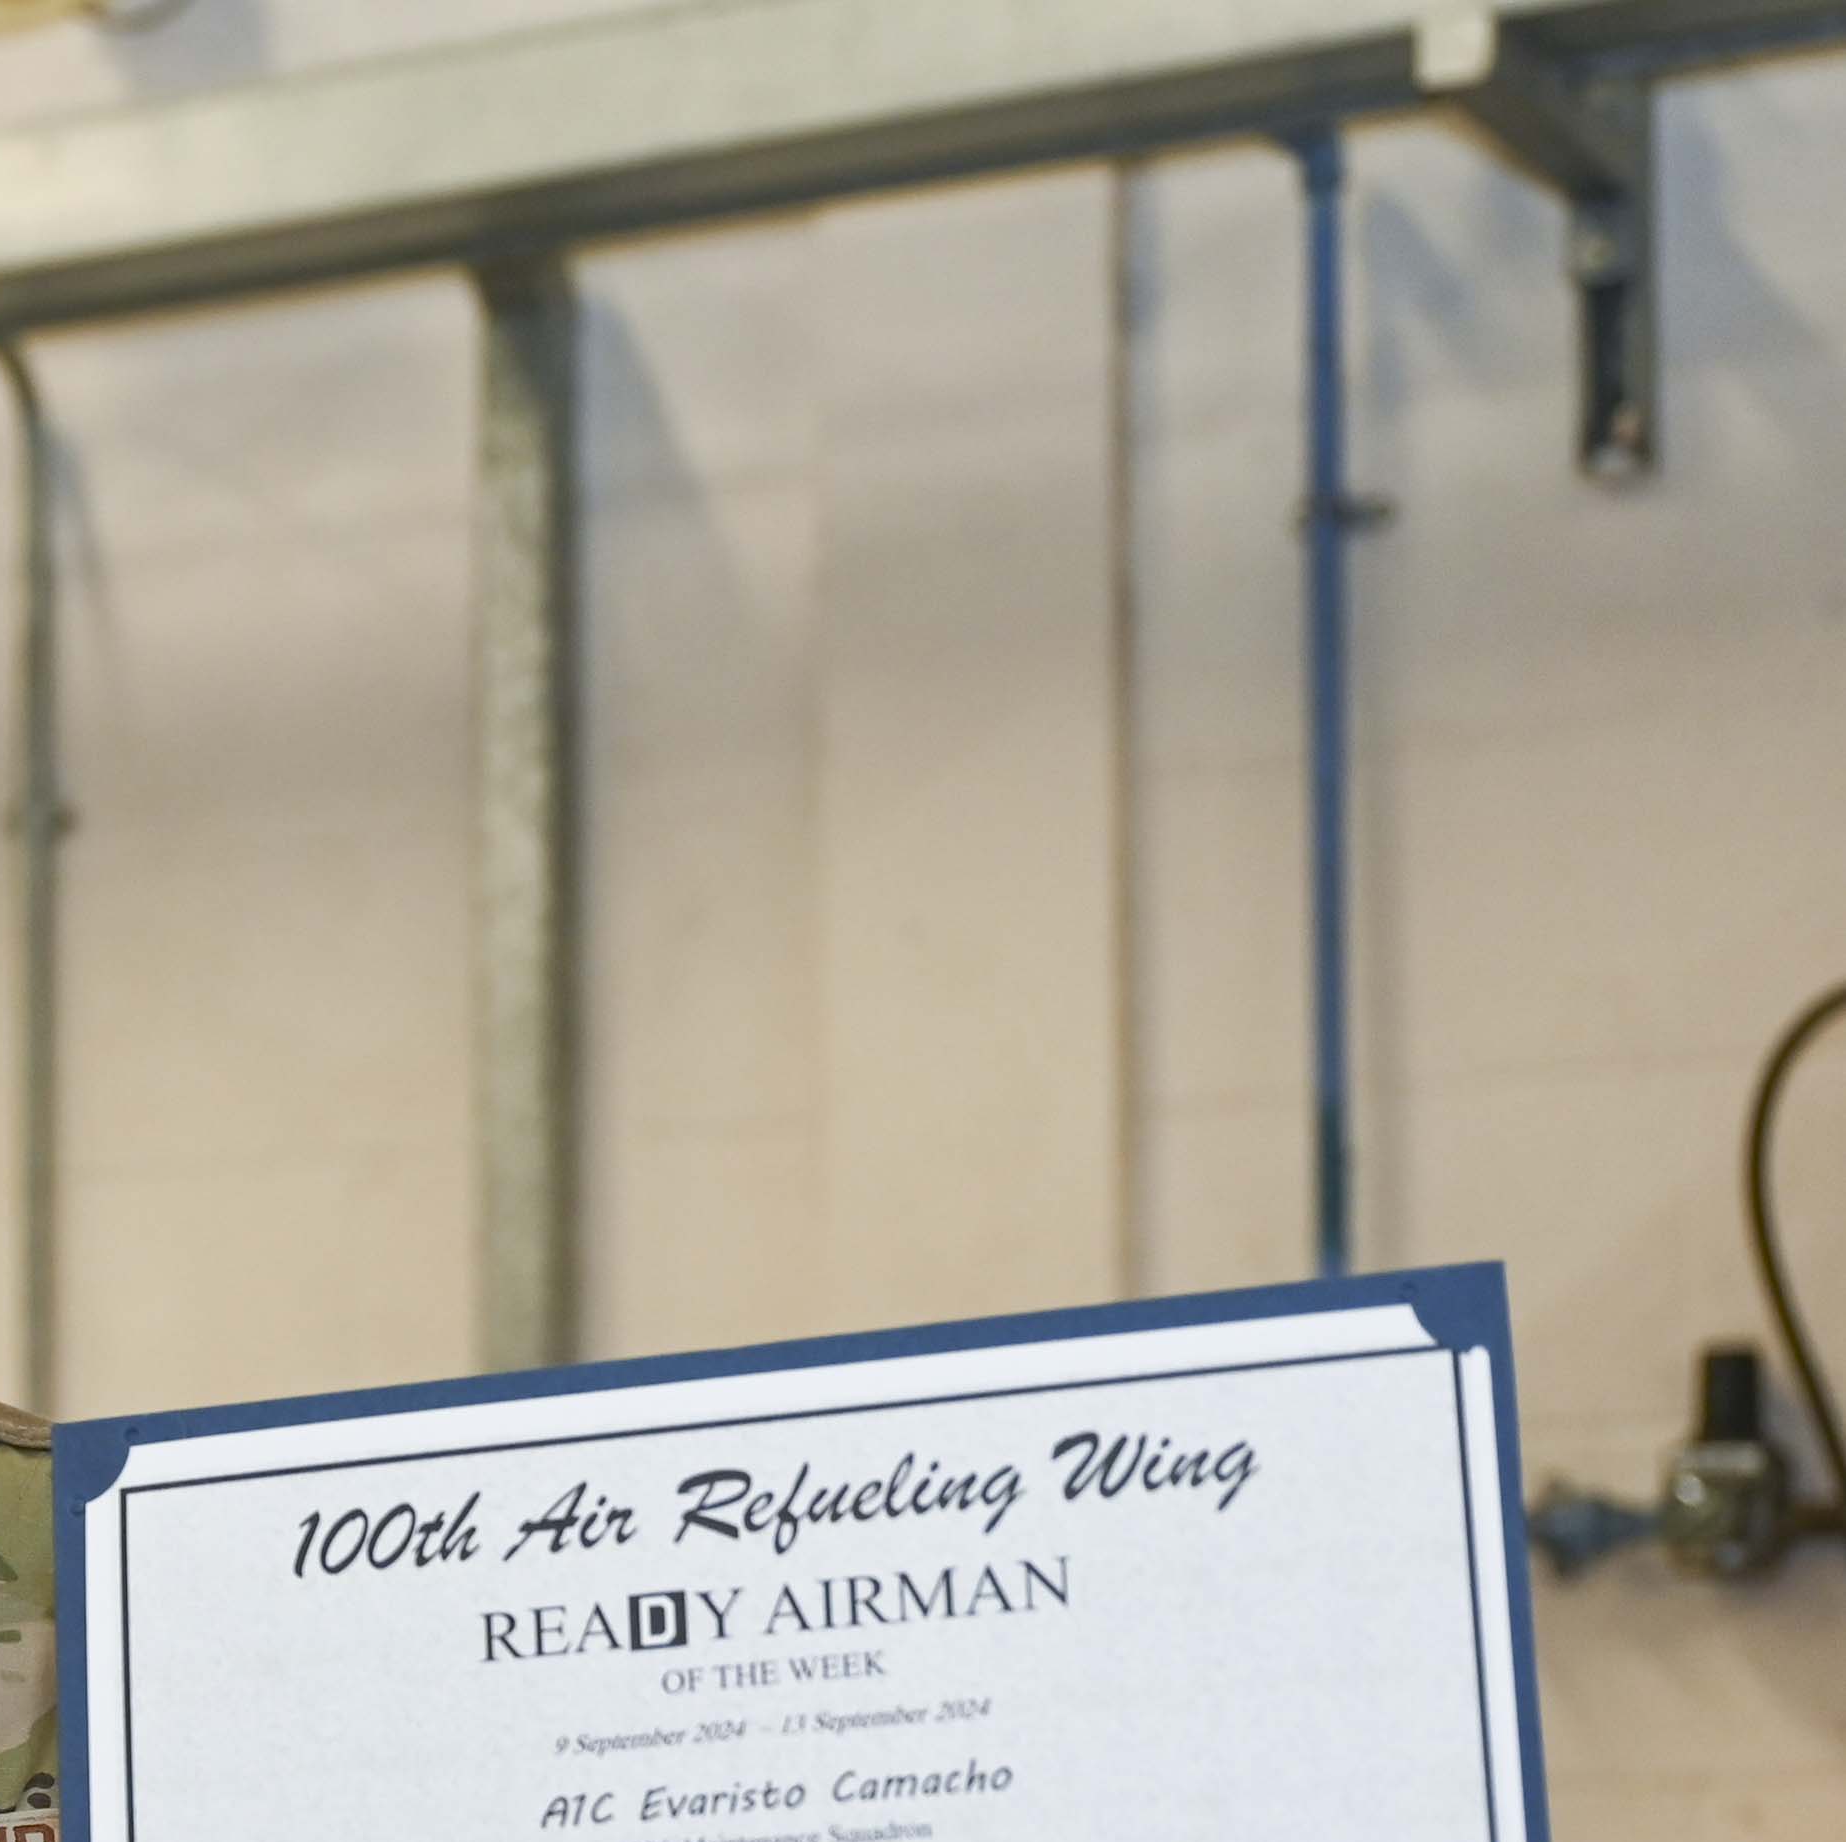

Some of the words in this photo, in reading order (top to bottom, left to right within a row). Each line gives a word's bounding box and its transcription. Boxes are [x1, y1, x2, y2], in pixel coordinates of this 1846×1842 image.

[292, 1490, 481, 1578] 100th
[503, 1480, 637, 1562] Air
[672, 1451, 1028, 1555] Refueling
[1051, 1431, 1262, 1512] Wing
[480, 1587, 744, 1663] READY
[763, 1555, 1072, 1637] AIRMAN
[660, 1666, 704, 1696] OF
[712, 1659, 781, 1690] THE
[787, 1649, 887, 1684] WEEK
[554, 1736, 570, 1756] 9
[574, 1727, 685, 1758] September
[692, 1719, 747, 1745] 2024
[779, 1713, 808, 1738] 13
[811, 1705, 930, 1737] September
[933, 1697, 992, 1724] 2024
[639, 1779, 807, 1823] Evaristo
[831, 1757, 1015, 1804] Camacho
